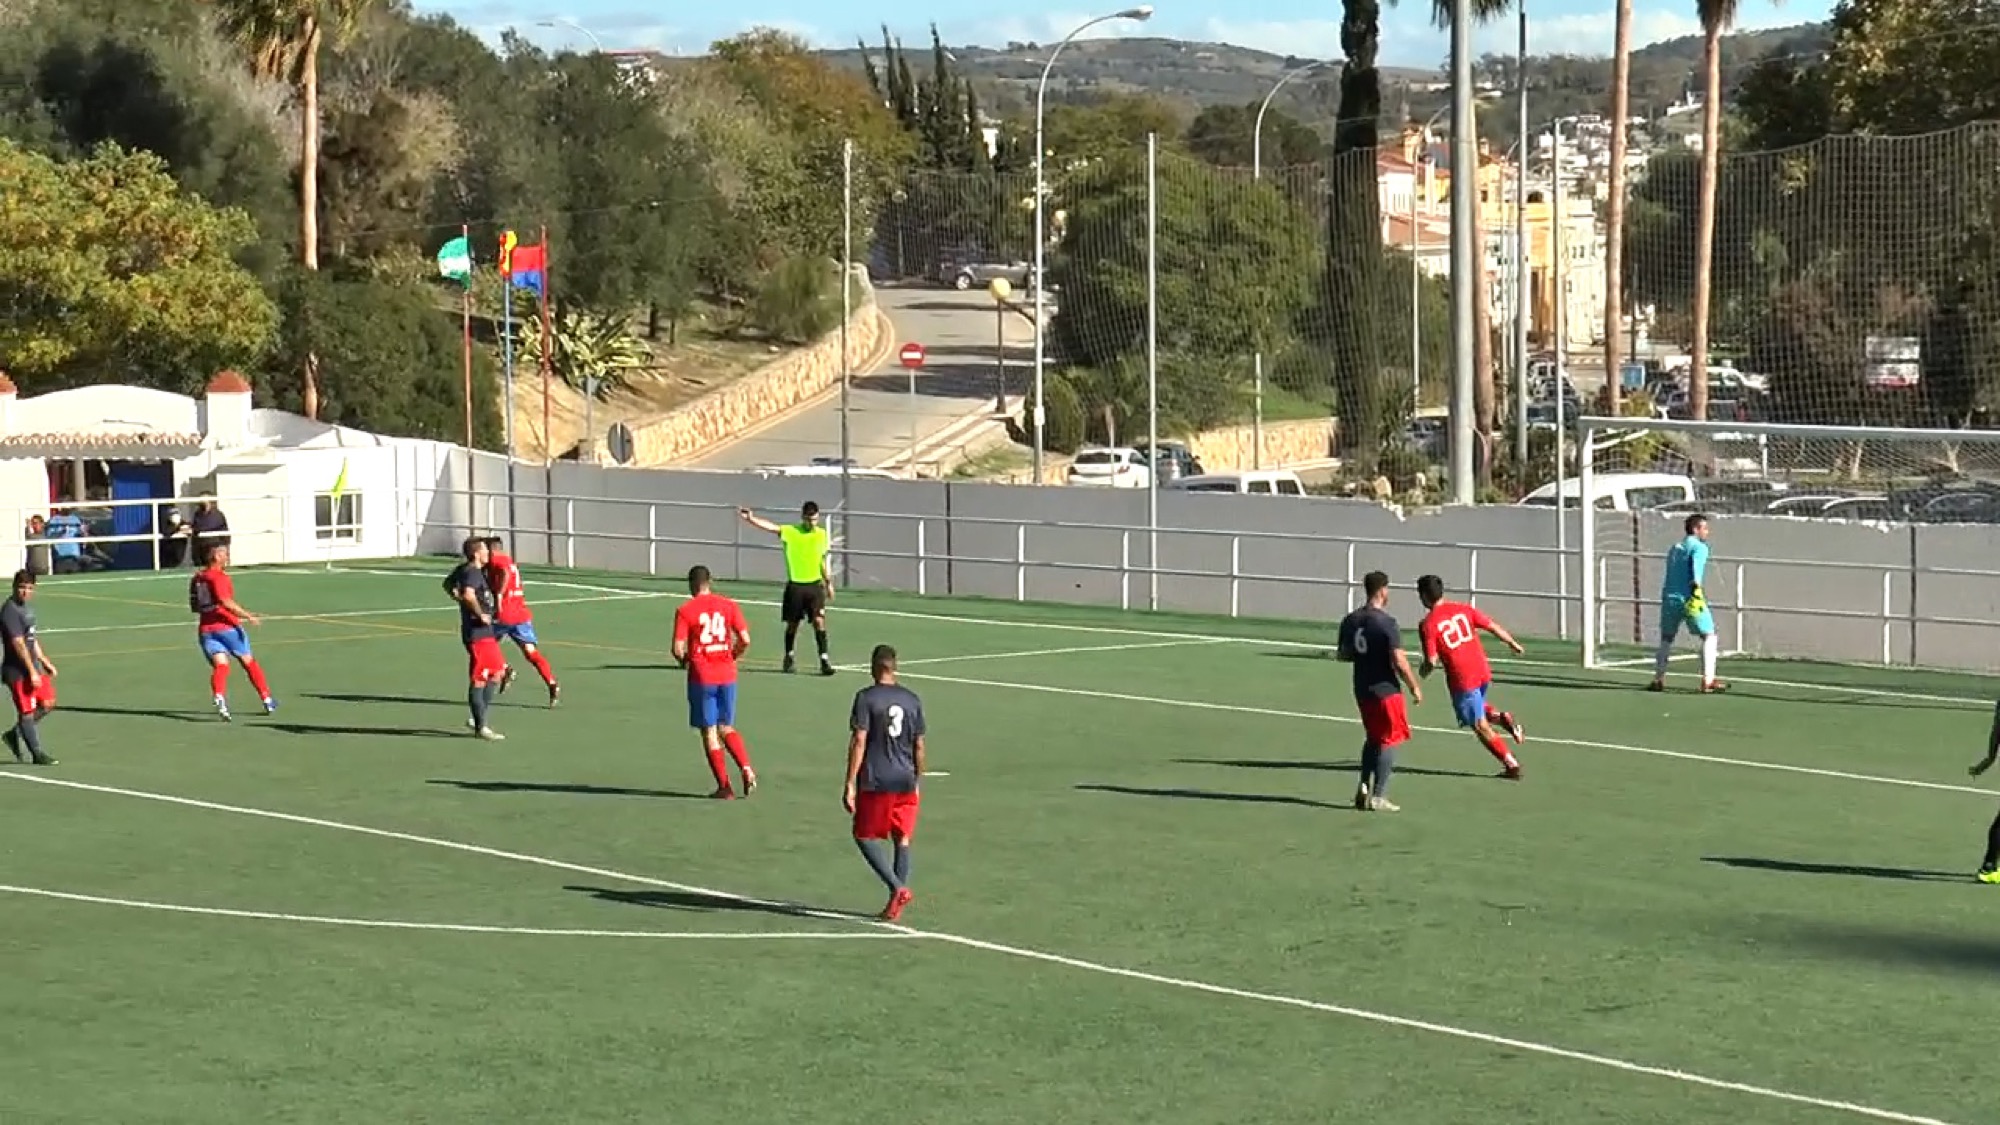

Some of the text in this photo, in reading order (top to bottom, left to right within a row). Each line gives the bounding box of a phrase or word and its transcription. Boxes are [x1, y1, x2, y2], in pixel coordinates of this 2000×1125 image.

[699, 611, 726, 643] 24
[1354, 627, 1368, 654] 6
[1437, 613, 1473, 649] 20
[888, 704, 904, 737] 3
